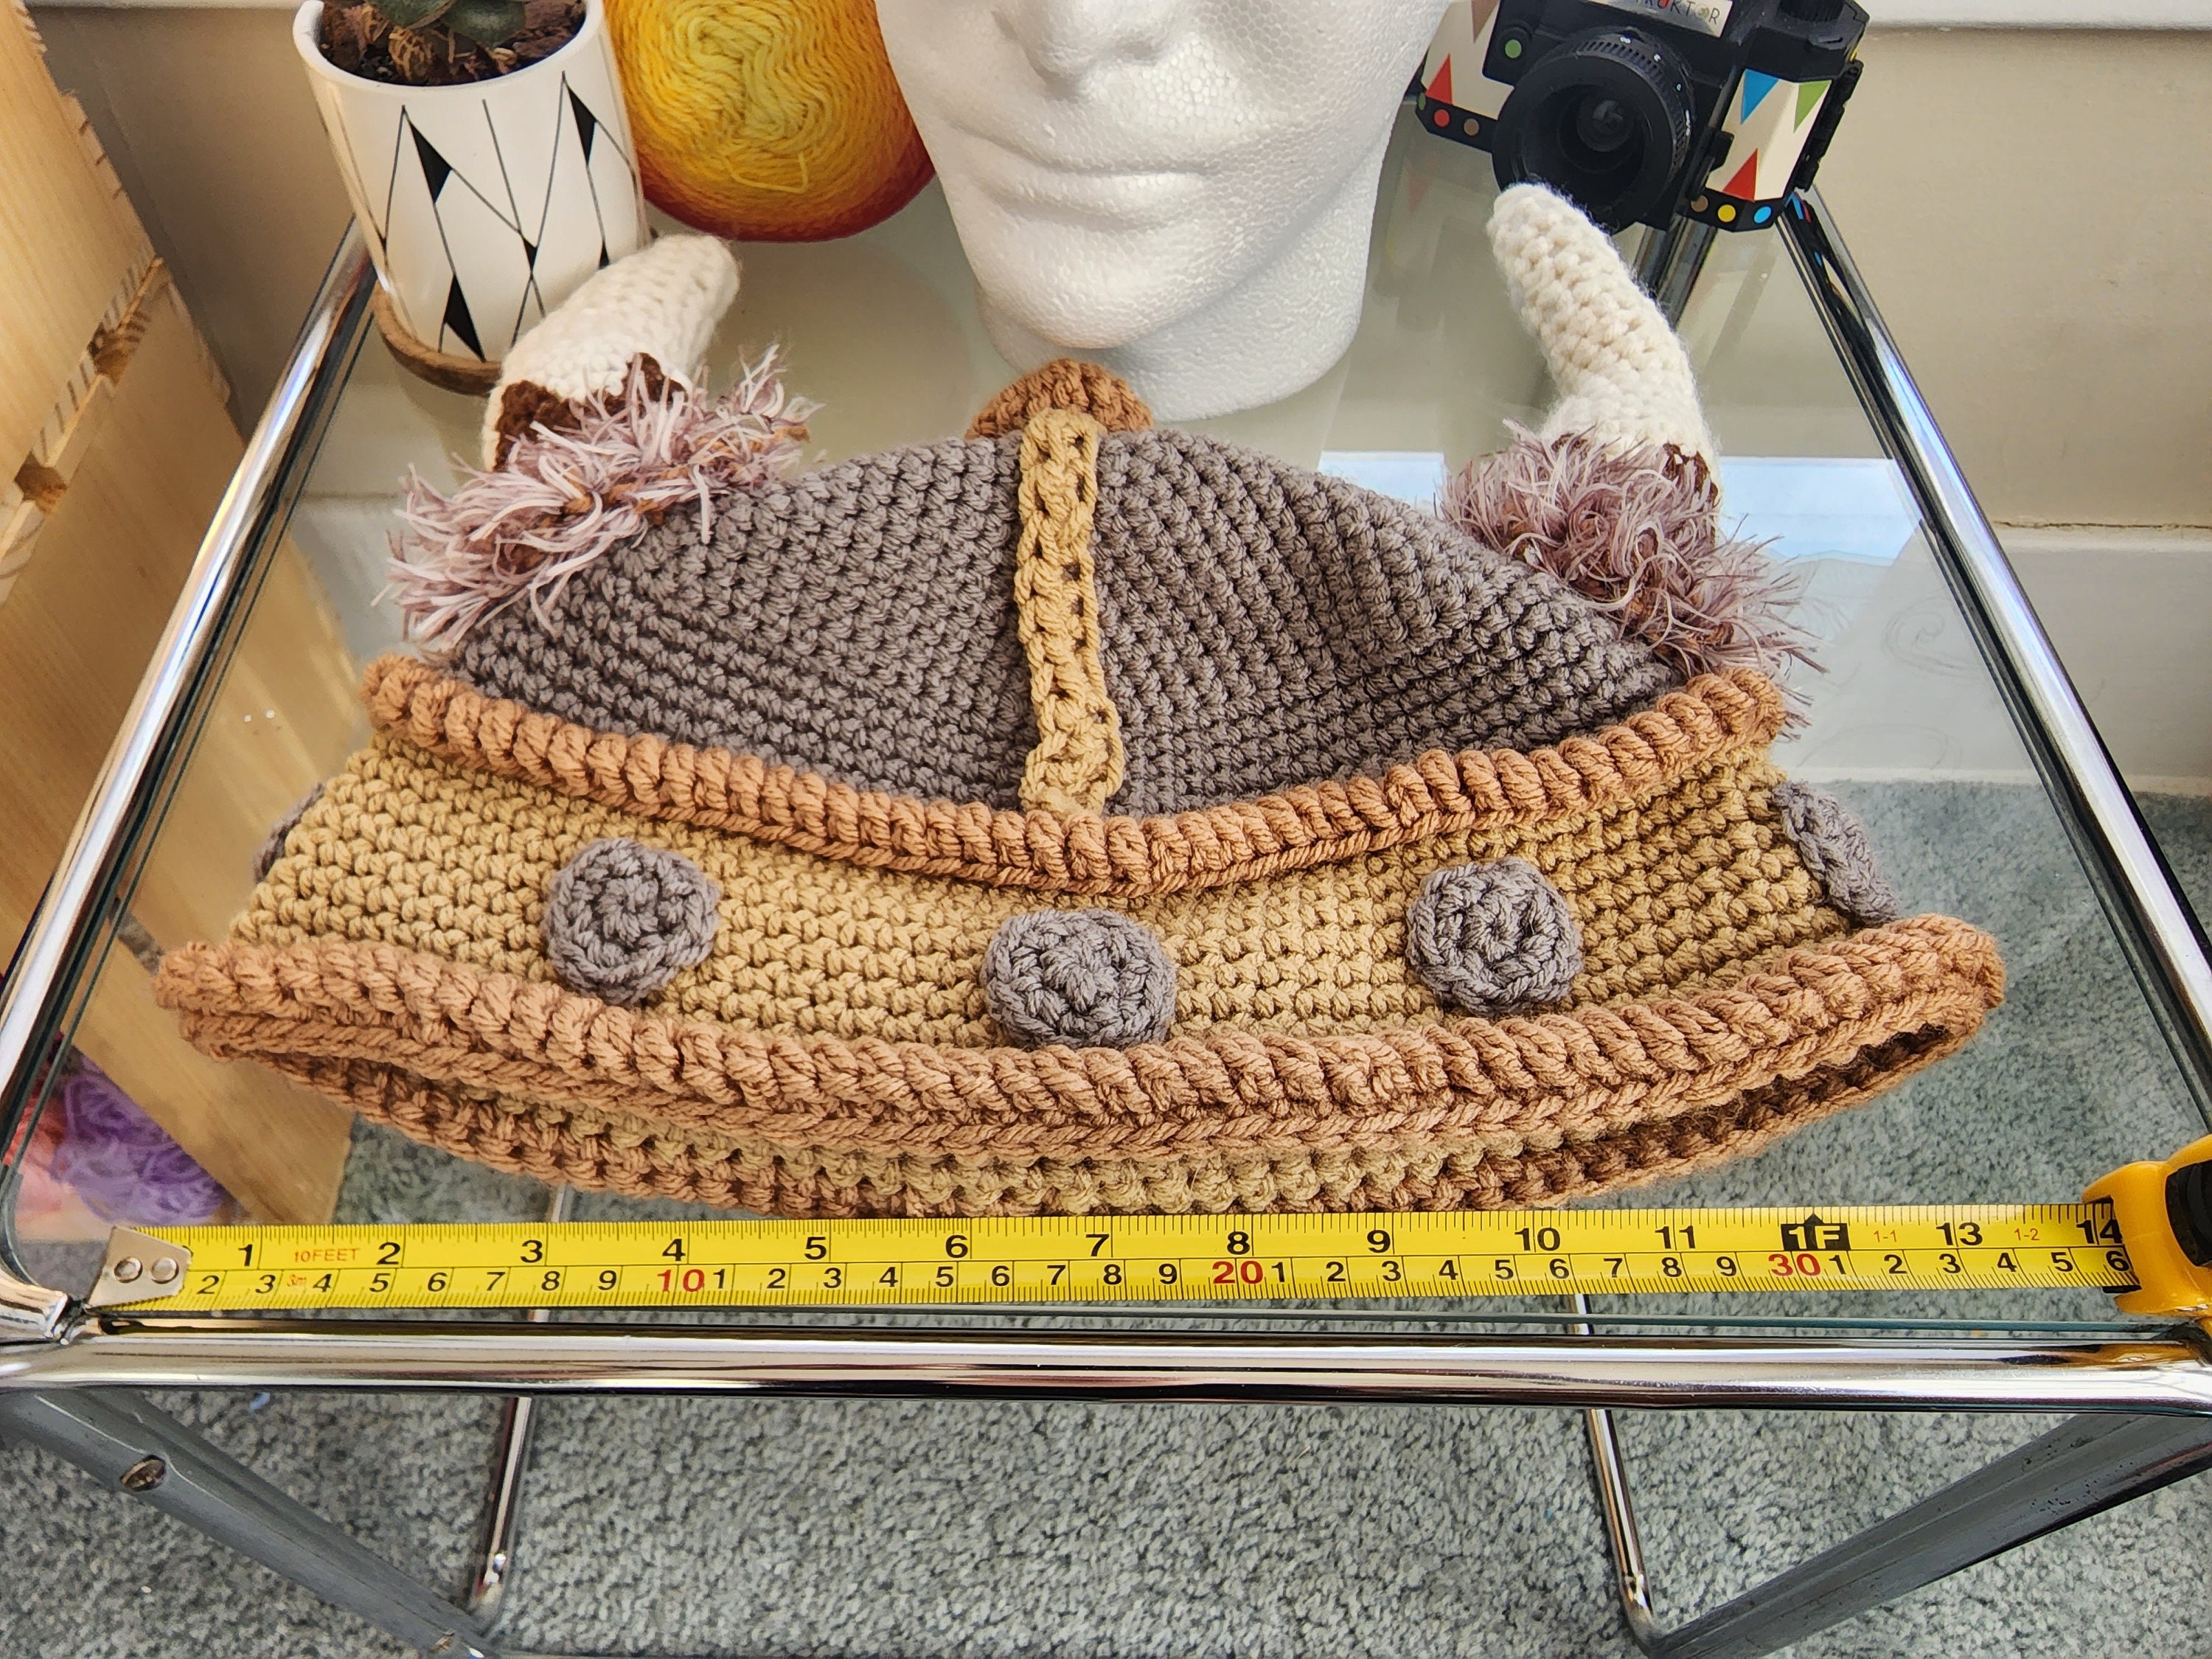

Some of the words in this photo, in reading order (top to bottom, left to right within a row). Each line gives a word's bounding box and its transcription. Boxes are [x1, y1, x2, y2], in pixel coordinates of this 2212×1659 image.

[238, 1244, 254, 1267] 1
[376, 1242, 400, 1265] 2
[520, 1239, 543, 1263] 3
[663, 1238, 686, 1262] 4
[804, 1237, 827, 1260] 5
[945, 1234, 968, 1258] 6
[1085, 1234, 1110, 1257] 7
[1227, 1231, 1250, 1255] 8
[1366, 1229, 1391, 1253] 9
[1514, 1228, 1561, 1251] 10
[1655, 1225, 1696, 1249] 11
[1874, 1231, 1896, 1242] 1-1
[1937, 1222, 1983, 1245] 13
[2014, 1228, 2039, 1240] 1-2
[2076, 1219, 2123, 1244] 14
[1382, 1261, 1401, 1281] 3
[1439, 1260, 1458, 1280] 4
[1494, 1259, 1514, 1280] 5
[1549, 1259, 1570, 1279] 6
[1603, 1258, 1623, 1278] 7
[1661, 1257, 1682, 1277] 8
[1716, 1256, 1736, 1276] 9
[1768, 1253, 1820, 1276] 30
[1829, 1255, 1846, 1275] 1
[1883, 1255, 1907, 1274] 2
[1939, 1254, 1961, 1273] 3
[1997, 1253, 2017, 1272] 4
[2051, 1252, 2073, 1271] 5
[2105, 1251, 2129, 1271] 6
[428, 1272, 446, 1292] 6
[486, 1272, 505, 1291] 7
[487, 1272, 506, 1291] 7
[542, 1271, 560, 1290] 8
[597, 1270, 617, 1290] 9
[658, 1269, 704, 1292] 10
[713, 1270, 726, 1289] 1
[767, 1269, 785, 1289] 2
[824, 1268, 841, 1288] 3
[879, 1267, 898, 1286] 4
[935, 1266, 954, 1287] 5
[991, 1265, 1010, 1286] 6
[1047, 1265, 1066, 1285] 7
[1103, 1265, 1122, 1284] 8
[1158, 1264, 1178, 1284] 9
[1213, 1261, 1263, 1284] 20
[1271, 1263, 1286, 1282] 1
[1326, 1262, 1345, 1282] 2
[197, 1276, 220, 1295] 2
[255, 1275, 276, 1294] 3
[313, 1273, 333, 1293] 4
[369, 1273, 389, 1292] 5
